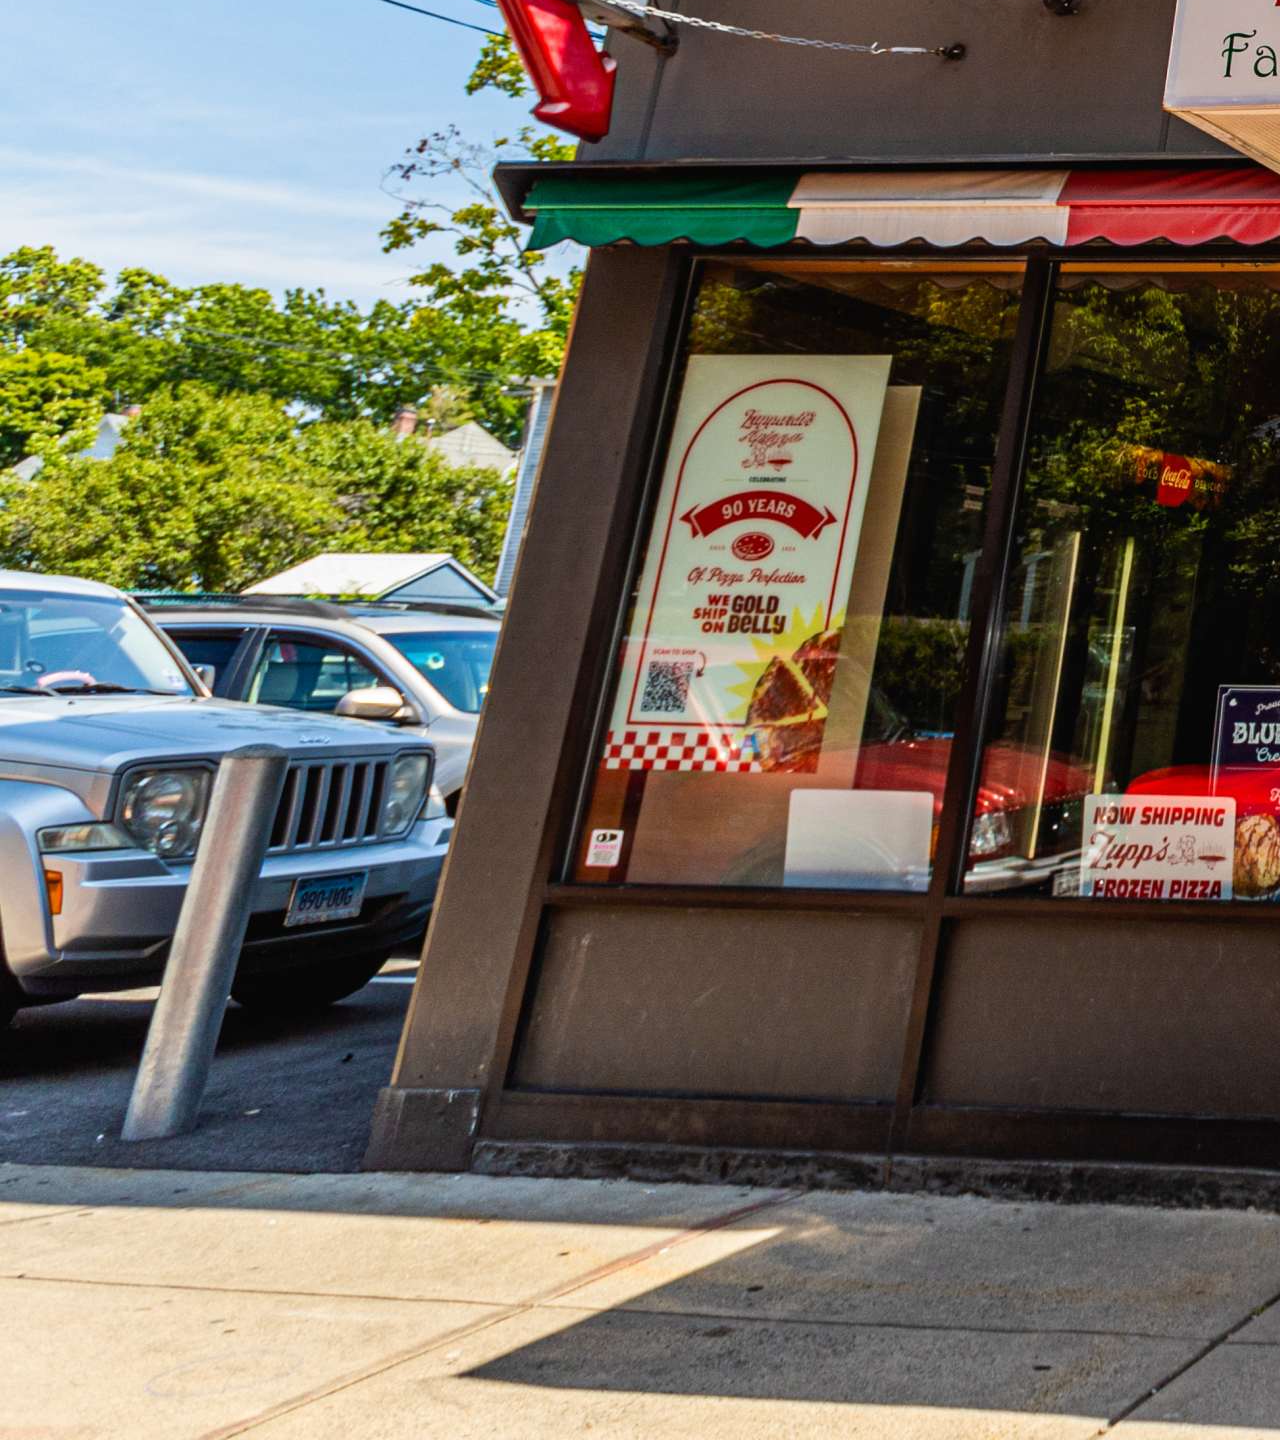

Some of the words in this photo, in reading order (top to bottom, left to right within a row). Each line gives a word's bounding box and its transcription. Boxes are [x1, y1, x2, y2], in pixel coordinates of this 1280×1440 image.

[721, 499, 744, 520] 90
[747, 497, 797, 519] YEARS
[706, 567, 745, 587] Pizza
[747, 567, 807, 587] Perfection
[708, 594, 731, 607] WE
[731, 595, 780, 614] GOLD
[692, 607, 728, 620] SHIP
[701, 621, 725, 634] ON
[1093, 806, 1137, 825] NOW
[1140, 806, 1226, 827] SHIPPING
[1088, 829, 1171, 871] Zupp's
[1092, 878, 1165, 899] FROZEN
[1168, 879, 1222, 899] PIZZA
